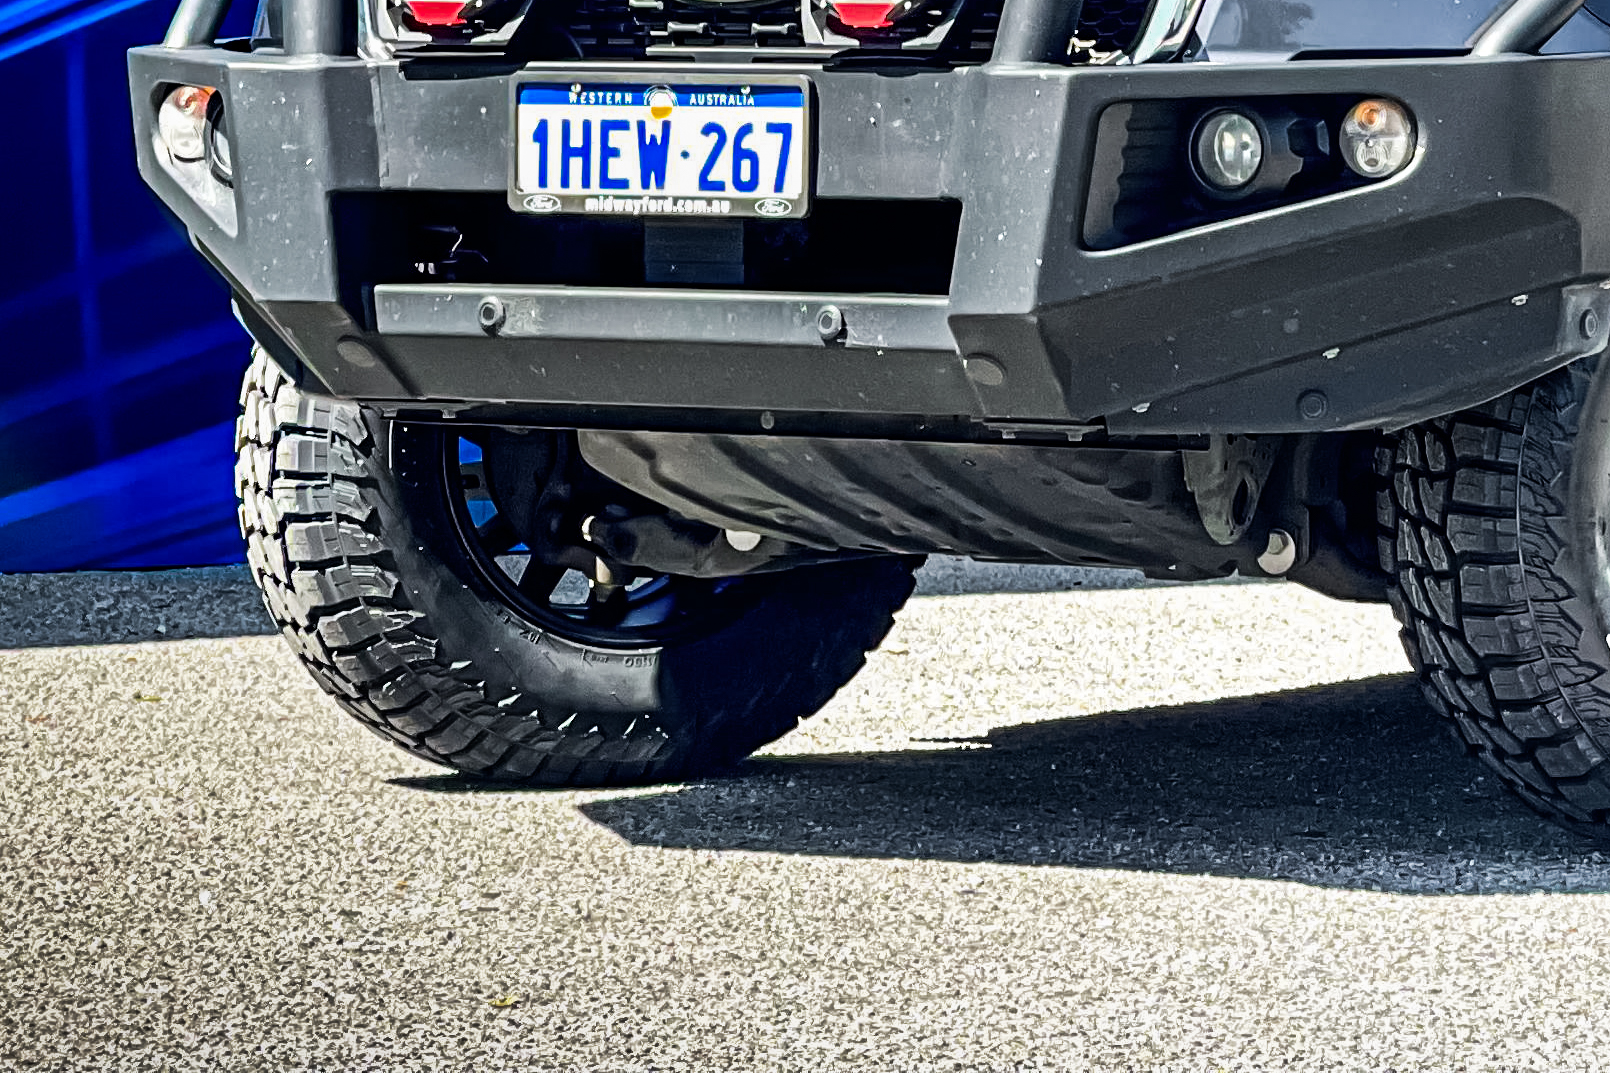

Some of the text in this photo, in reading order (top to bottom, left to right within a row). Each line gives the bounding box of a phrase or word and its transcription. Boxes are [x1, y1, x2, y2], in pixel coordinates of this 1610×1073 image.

[569, 92, 755, 106] WESTERN AUSTRALIA
[585, 196, 731, 215] midwayford.com.au
